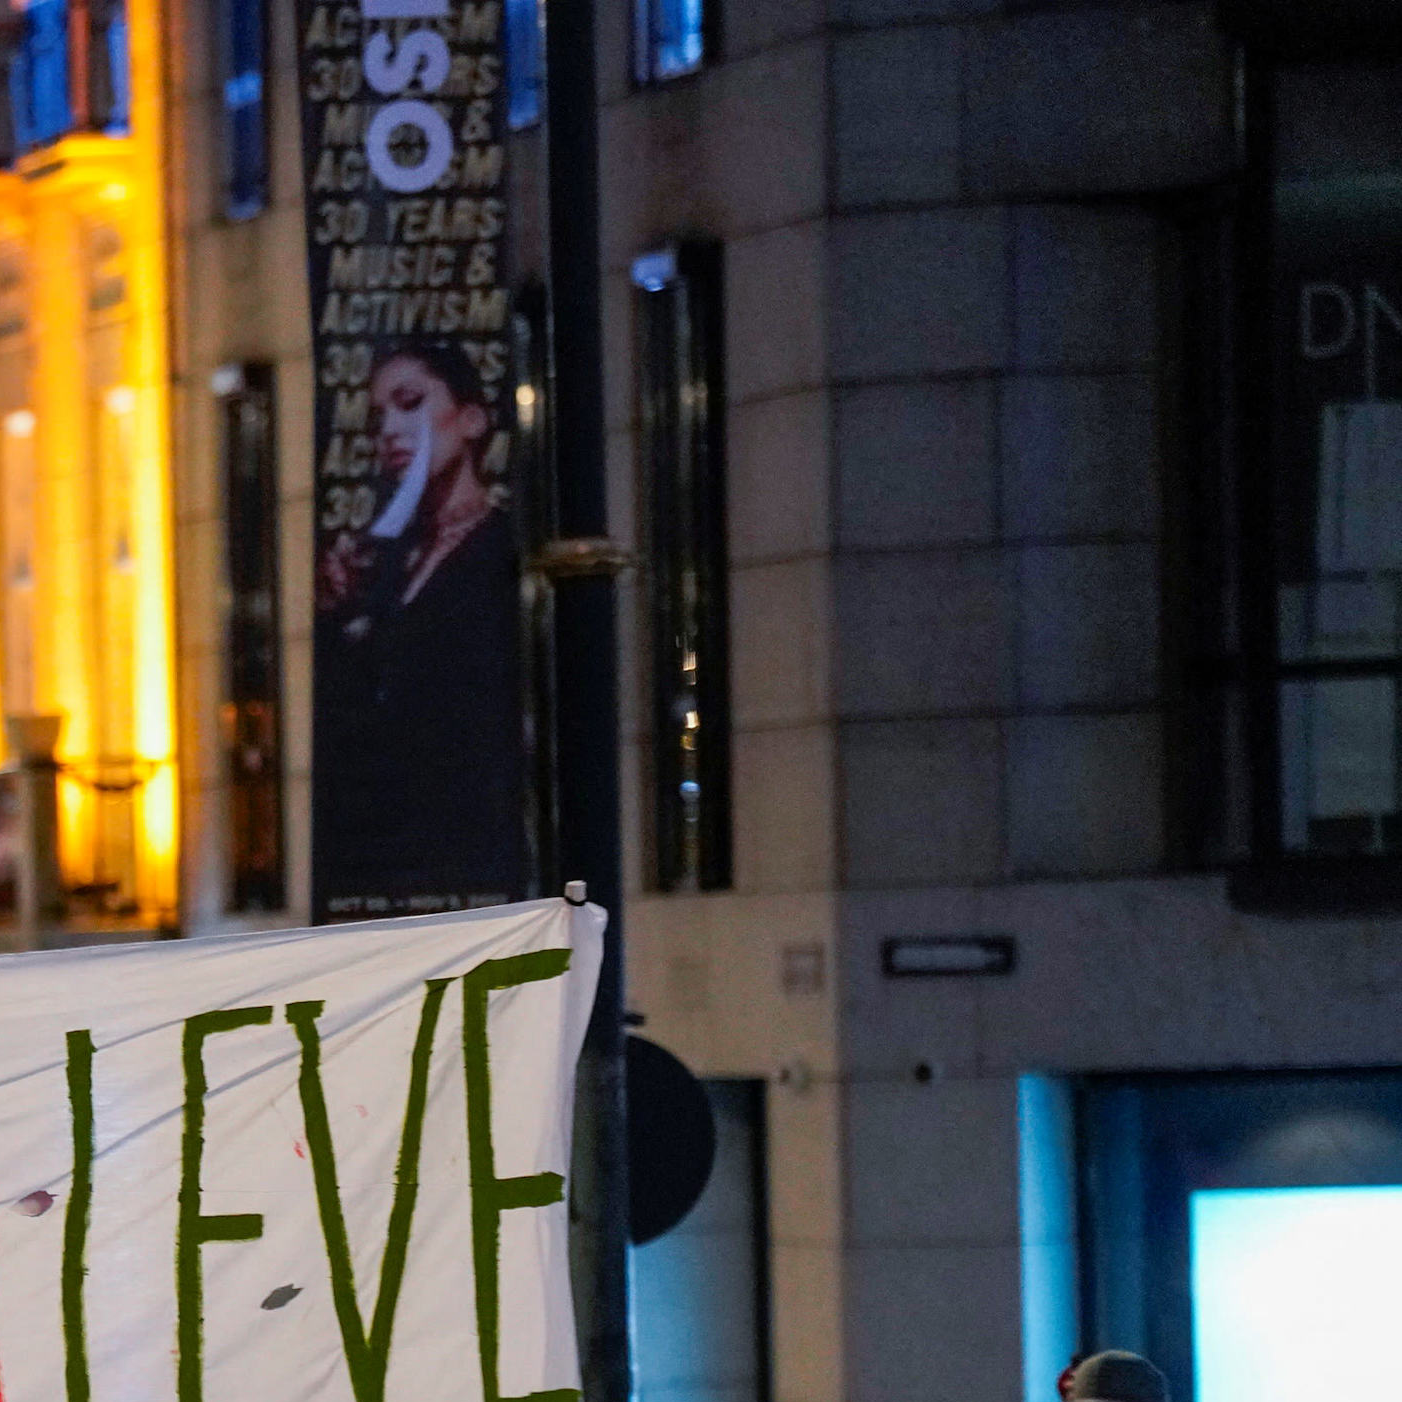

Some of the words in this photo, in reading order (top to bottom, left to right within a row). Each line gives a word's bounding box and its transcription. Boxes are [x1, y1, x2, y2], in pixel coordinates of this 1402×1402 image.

[314, 200, 369, 245] 30
[386, 198, 508, 243] YEARS
[329, 246, 456, 291] MUSIC
[465, 243, 496, 288] &
[320, 288, 511, 336] ACTIVISM
